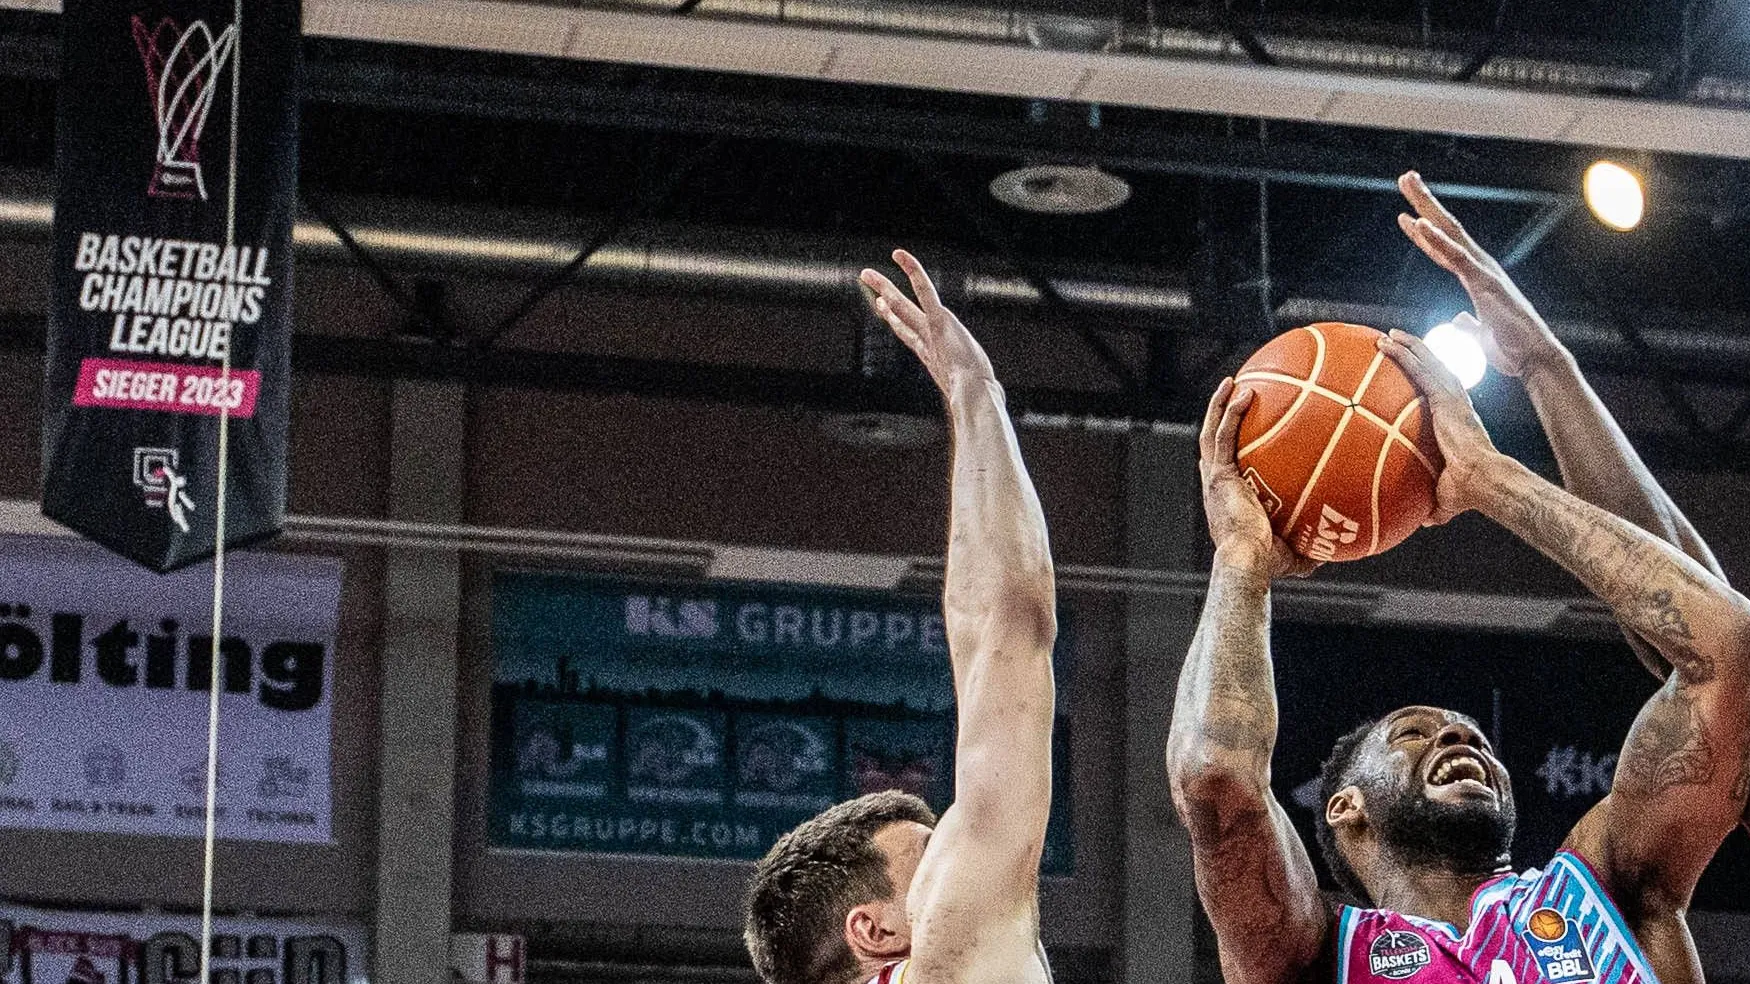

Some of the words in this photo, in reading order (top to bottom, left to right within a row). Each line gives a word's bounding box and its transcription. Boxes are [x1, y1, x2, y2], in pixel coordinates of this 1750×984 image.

[75, 232, 271, 285] BASKETBALL
[79, 275, 265, 324] CHAMPIONS
[109, 322, 233, 360] LEAGUE
[92, 368, 178, 404] SIEGER
[181, 373, 244, 410] 2023
[736, 600, 948, 653] GRUPPE
[485, 936, 522, 983] H
[1372, 948, 1428, 971] BASKETS
[1546, 958, 1590, 980] BBL
